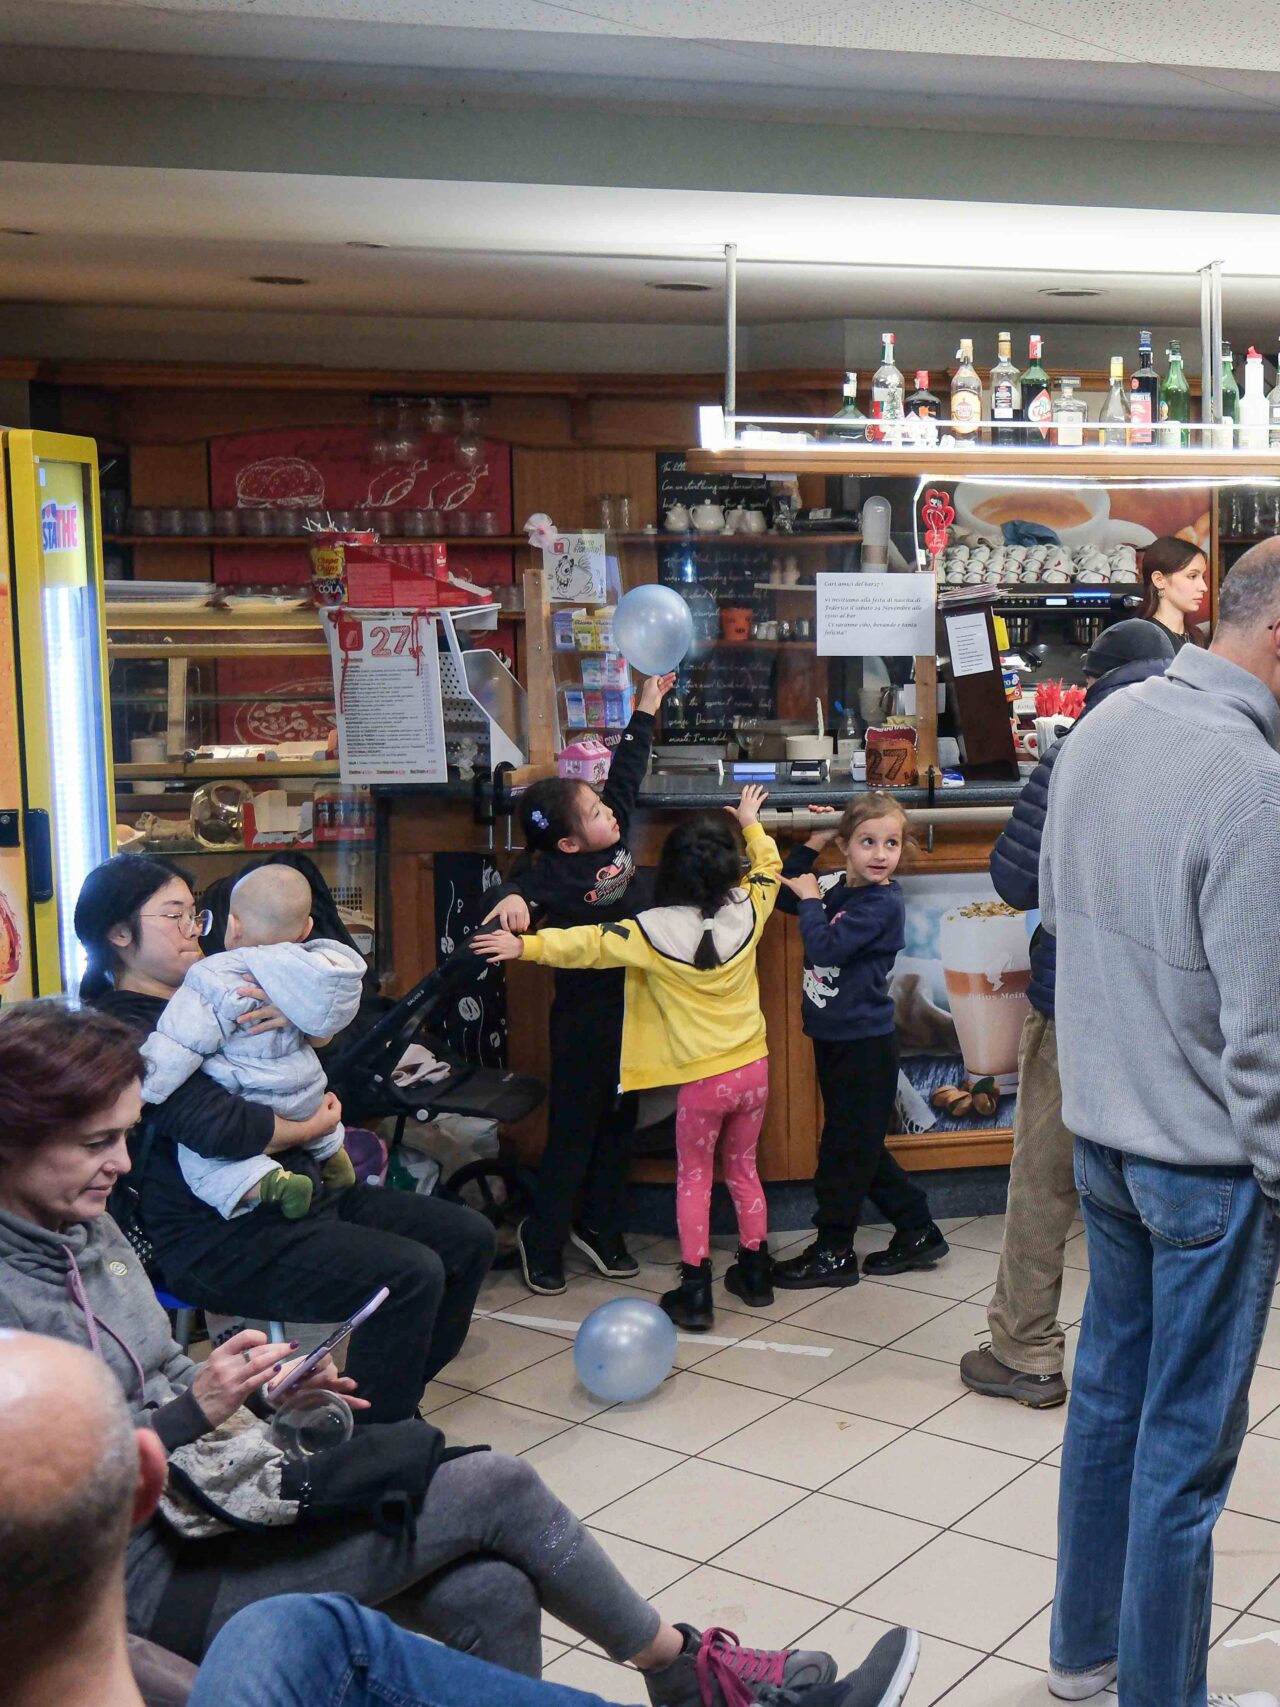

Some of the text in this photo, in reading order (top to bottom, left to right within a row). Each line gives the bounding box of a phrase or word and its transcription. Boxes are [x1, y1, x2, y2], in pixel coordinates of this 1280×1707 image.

[319, 584, 342, 594] COLA
[370, 625, 410, 657] 27
[866, 748, 908, 781] 27
[968, 992, 996, 1001] Julius
